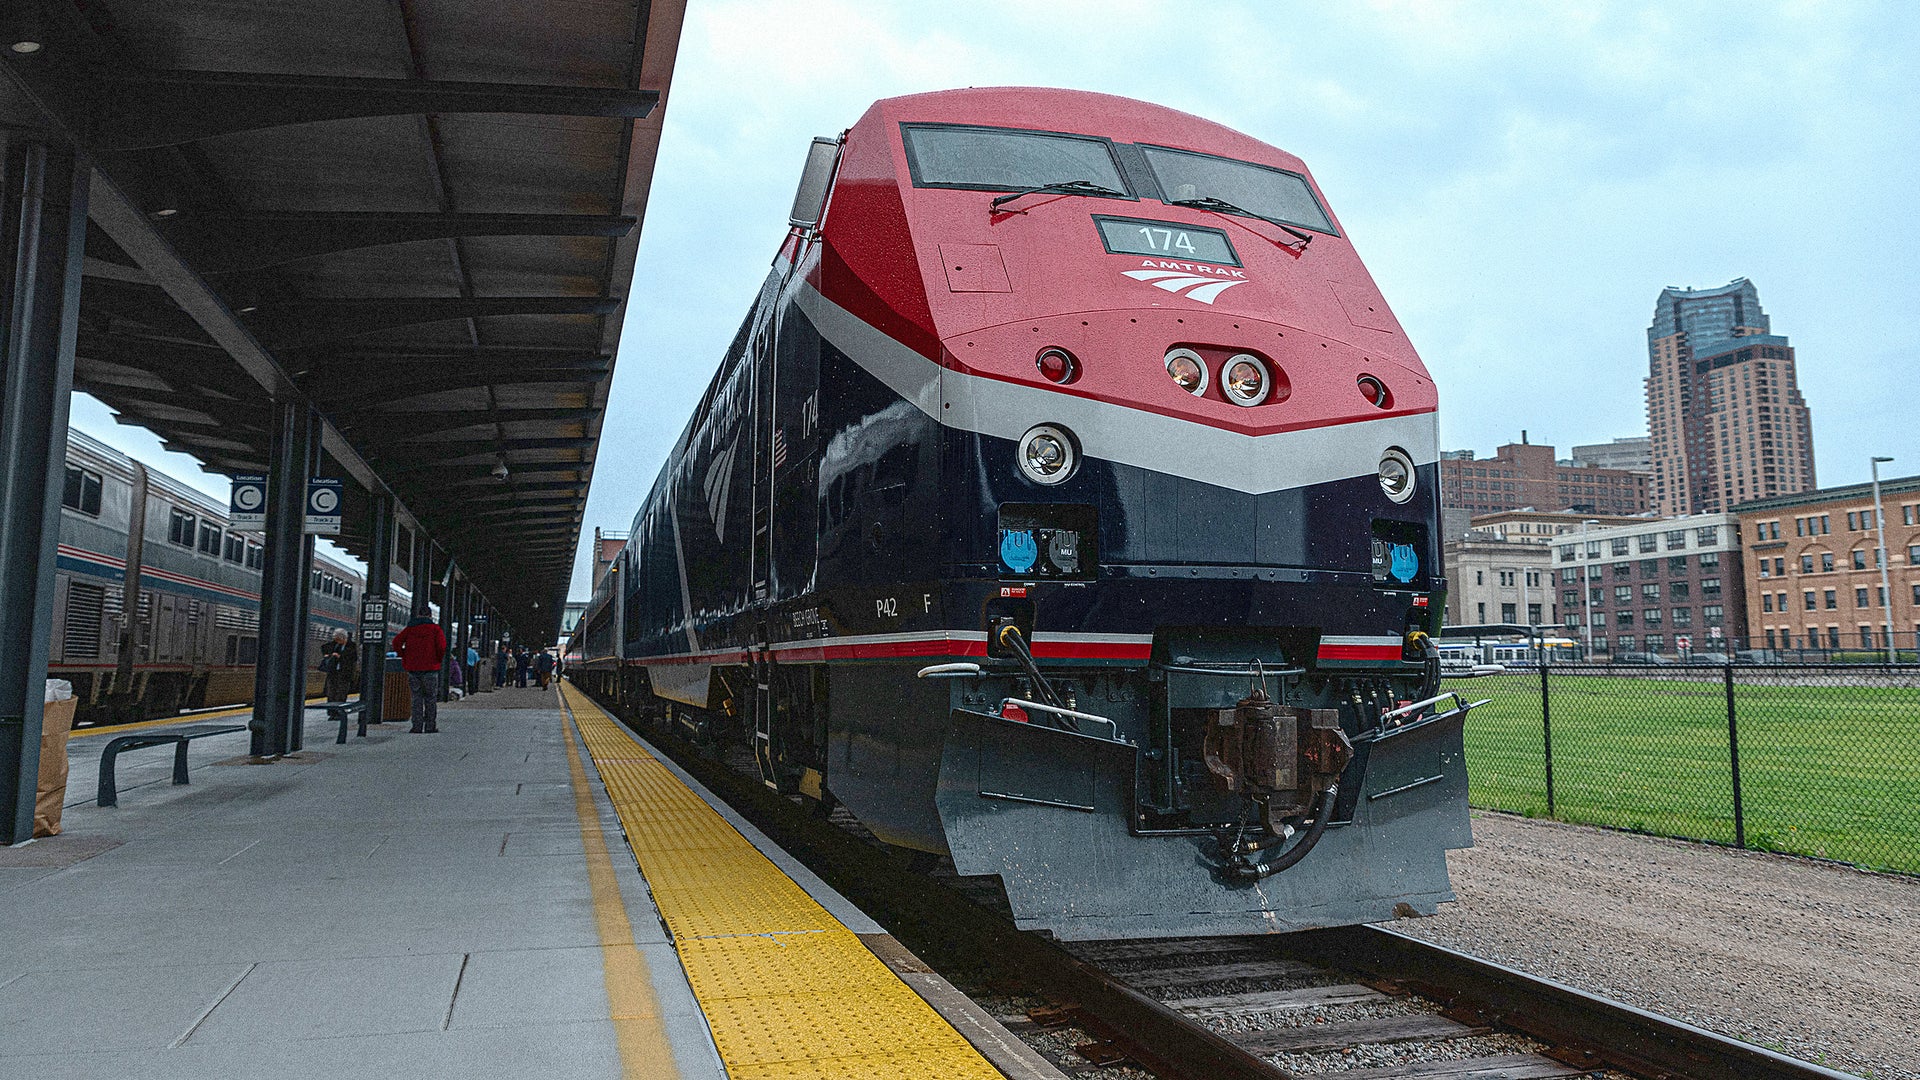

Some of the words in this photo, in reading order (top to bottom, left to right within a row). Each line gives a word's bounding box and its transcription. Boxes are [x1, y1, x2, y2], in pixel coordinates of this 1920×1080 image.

[1139, 227, 1196, 254] 174
[1141, 260, 1247, 279] AMTRAK
[802, 389, 819, 440] 174
[240, 489, 254, 506] C
[316, 492, 330, 509] C
[876, 597, 898, 618] P42
[923, 594, 931, 614] F
